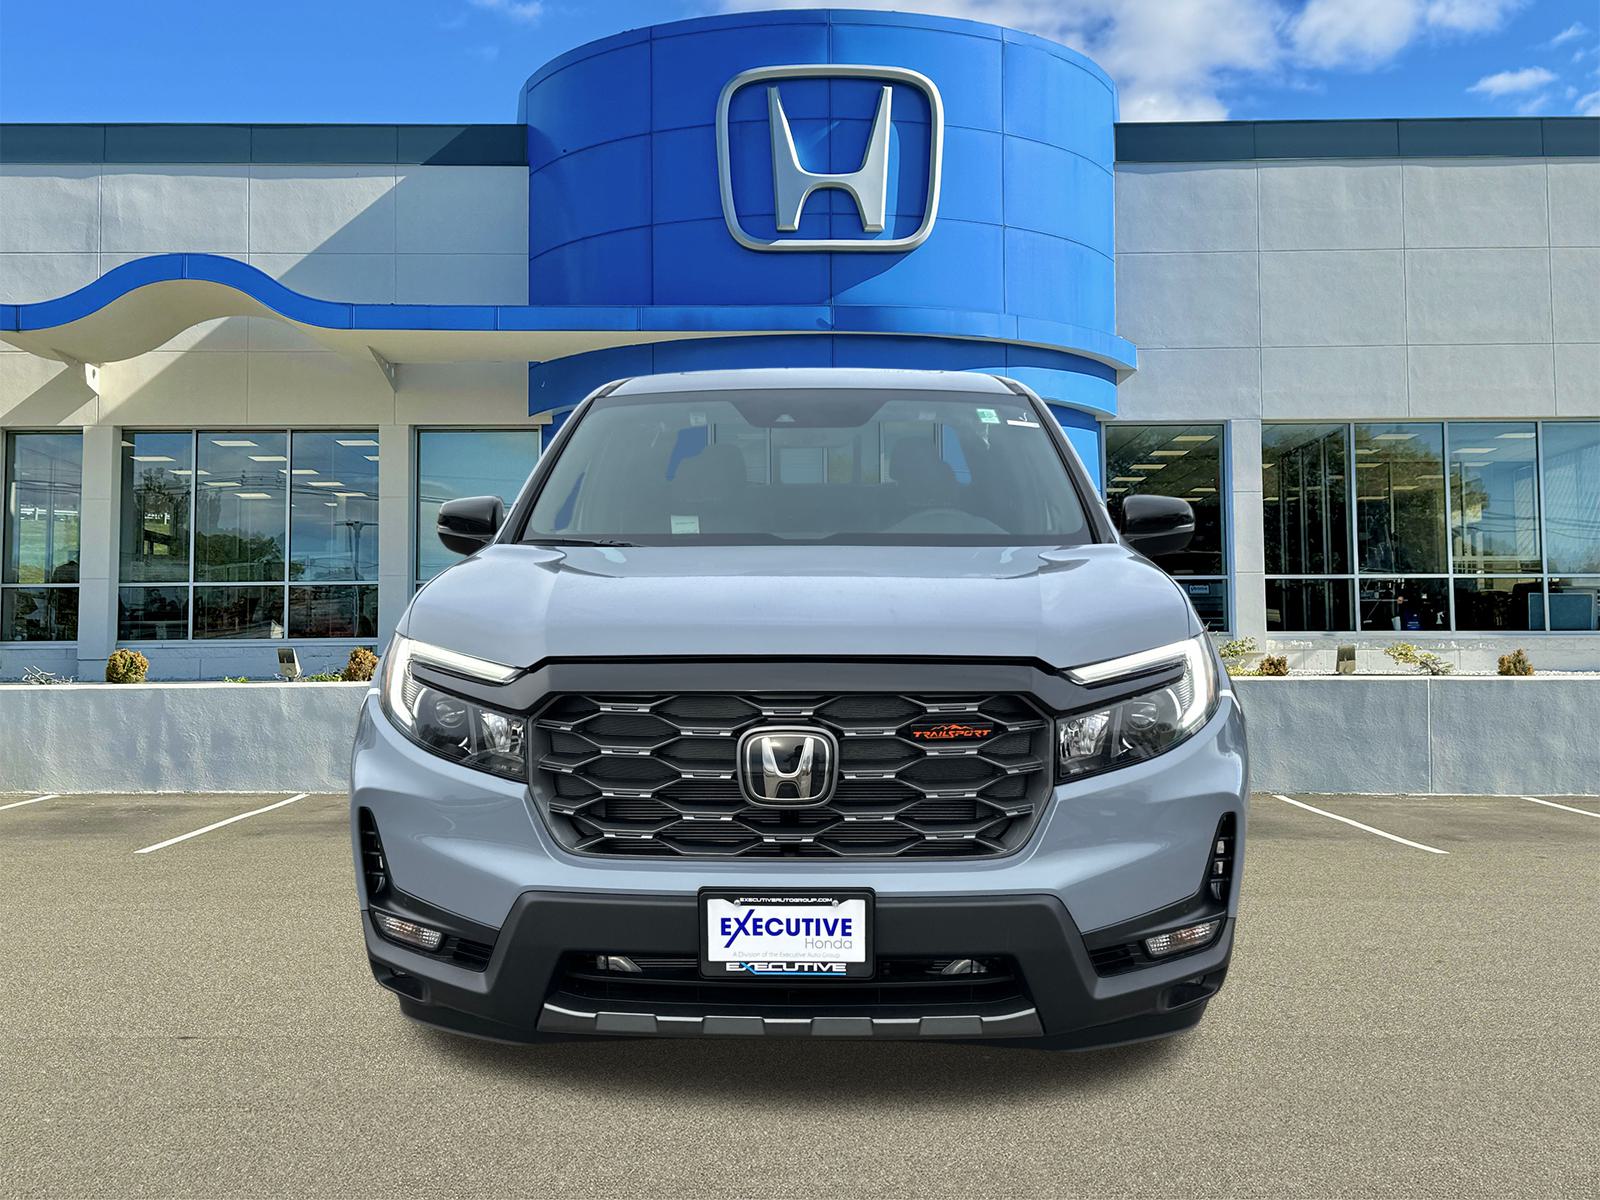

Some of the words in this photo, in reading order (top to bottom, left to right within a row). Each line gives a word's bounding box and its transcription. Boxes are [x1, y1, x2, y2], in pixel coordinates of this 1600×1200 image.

[913, 729, 992, 739] TRAILSPORT
[720, 909, 853, 948] EXECUTIVE
[804, 938, 853, 950] Honda
[725, 962, 847, 975] EXECUTIVE
